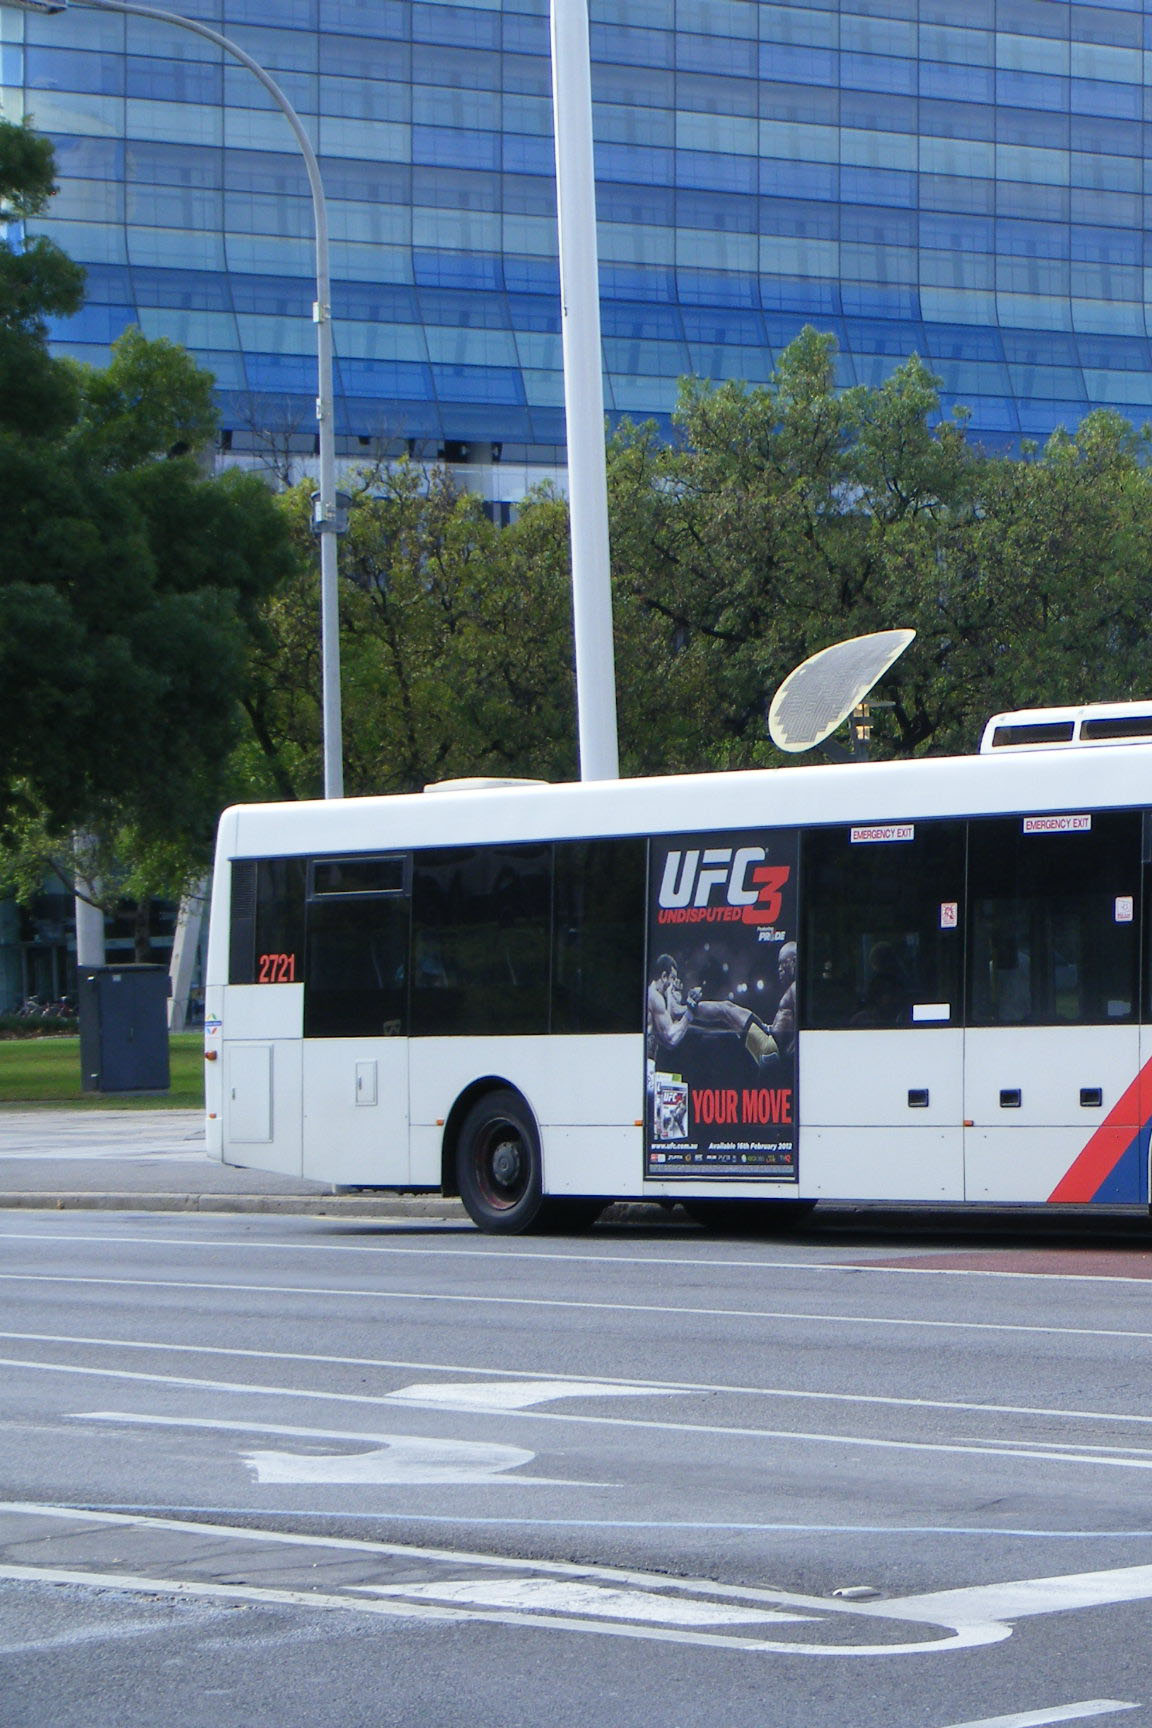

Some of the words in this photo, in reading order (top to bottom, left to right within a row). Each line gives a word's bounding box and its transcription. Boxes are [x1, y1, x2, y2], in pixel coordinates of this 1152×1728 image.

[1026, 819, 1071, 830] EMERGENCY
[1073, 817, 1089, 828] EXIT
[853, 830, 896, 840] EMERGENCY
[897, 828, 913, 838] EXIT
[658, 846, 766, 909] UFC
[741, 865, 790, 925] 3
[657, 906, 743, 924] UNDISPUTED
[259, 954, 295, 983] 2721
[692, 1088, 738, 1125] YOUR
[742, 1088, 792, 1125] MOVE
[651, 1142, 699, 1150] www.ufc.com.au
[708, 1142, 736, 1150] Available
[750, 1142, 777, 1151] February
